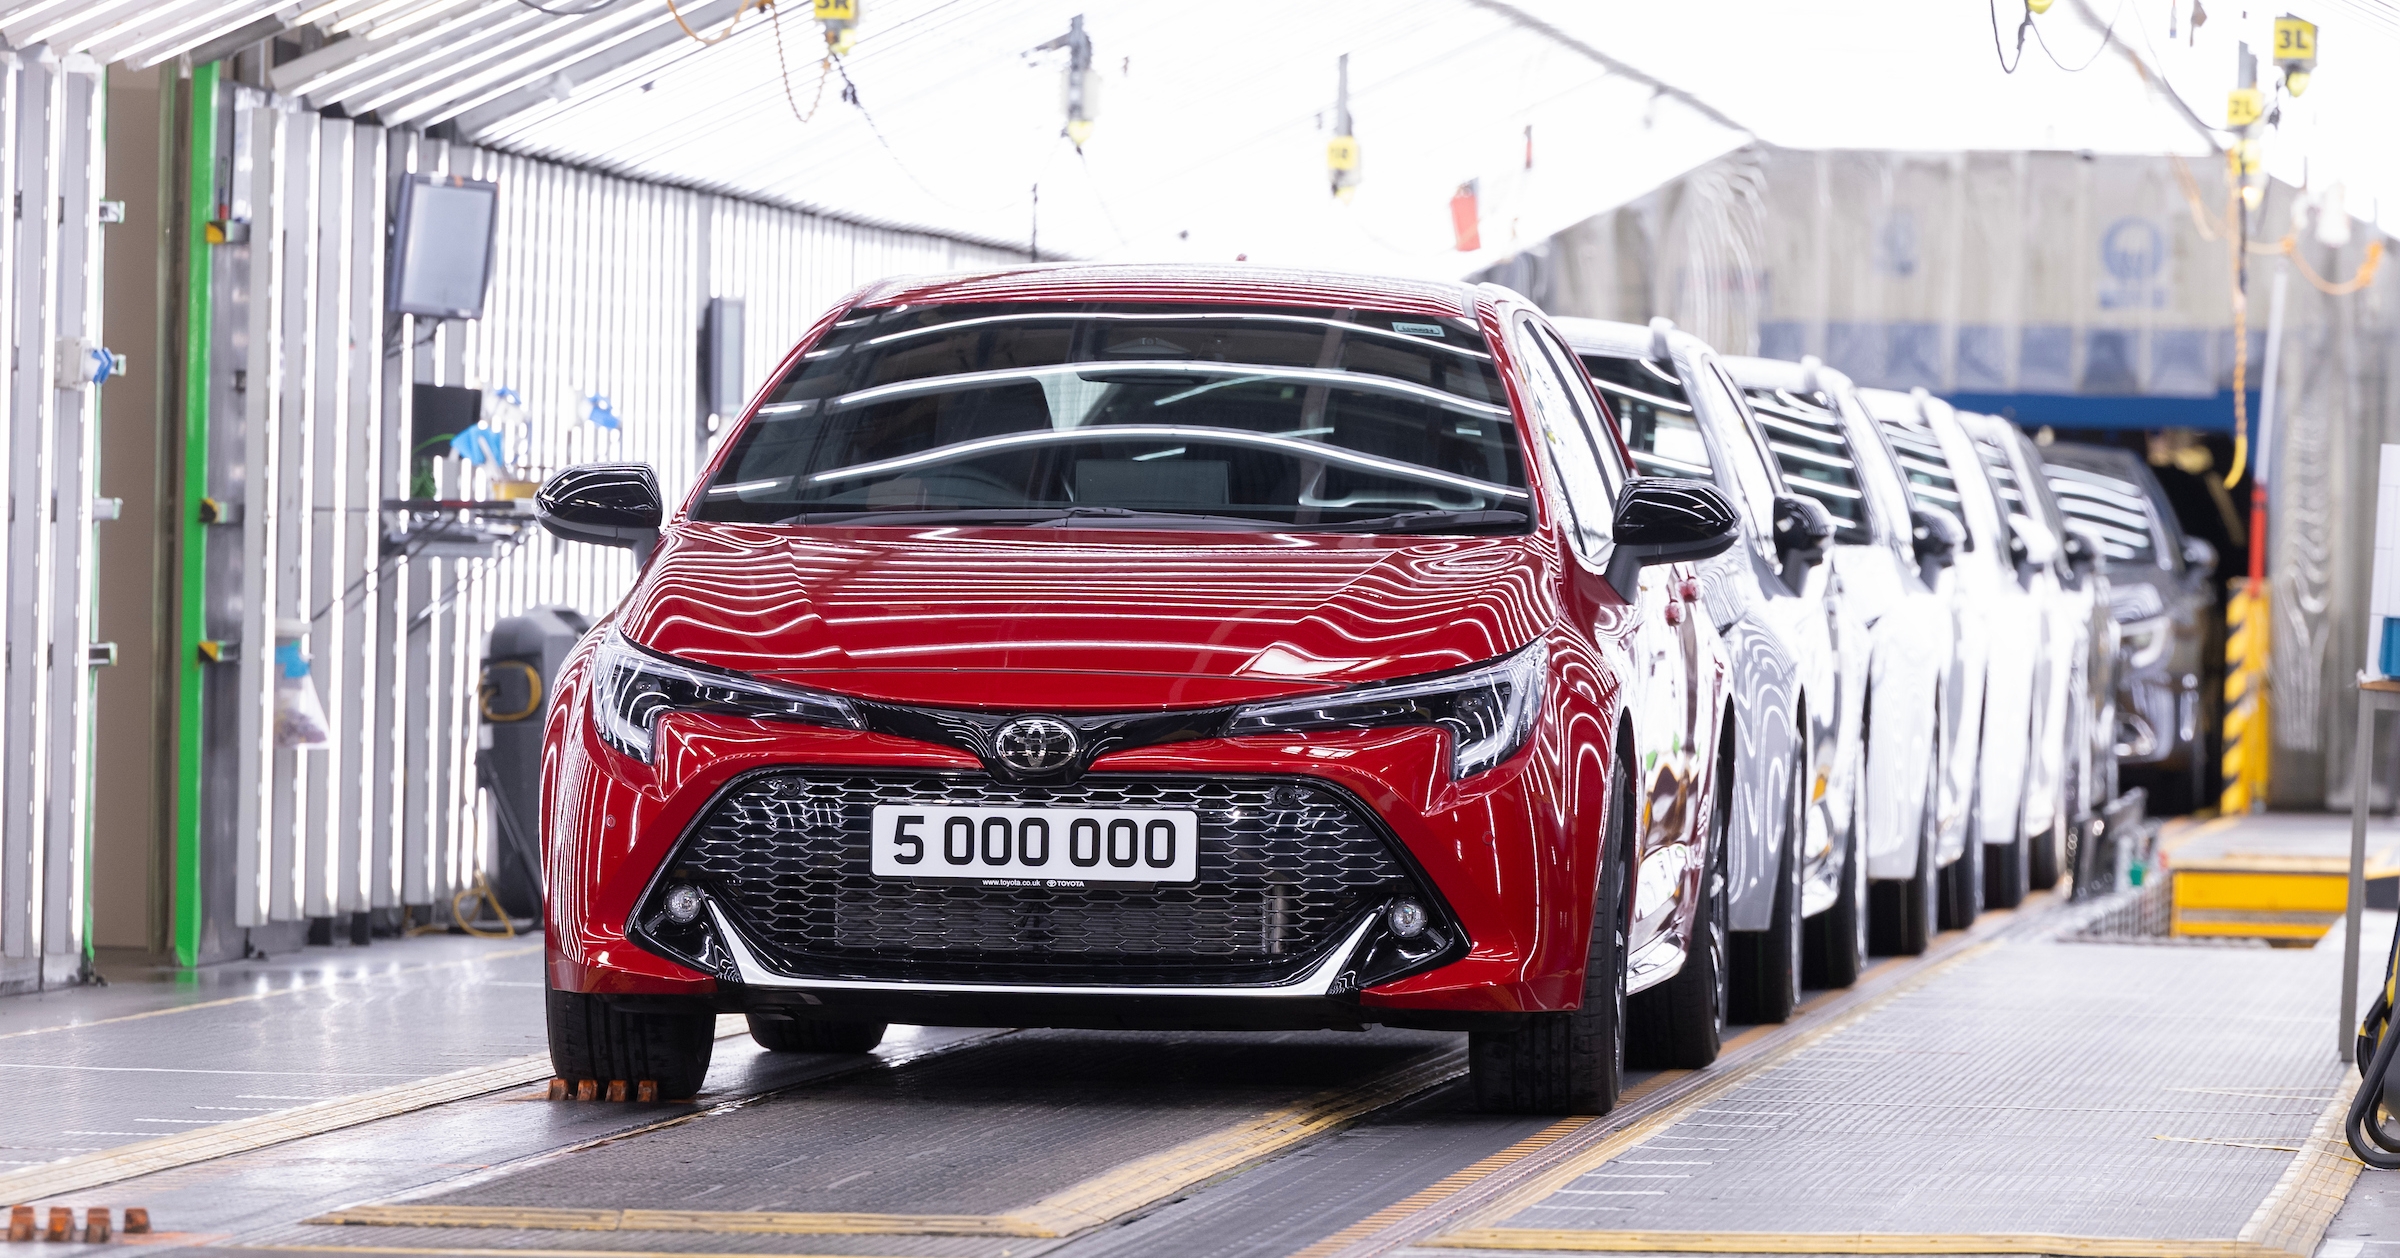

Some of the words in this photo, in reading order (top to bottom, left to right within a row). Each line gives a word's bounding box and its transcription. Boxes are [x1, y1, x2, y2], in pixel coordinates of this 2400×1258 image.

[2279, 29, 2308, 49] 3L
[893, 815, 925, 865] 5
[943, 816, 1050, 866] 000
[1069, 817, 1176, 868] 000
[982, 879, 1041, 888] www.toyota.co.uk
